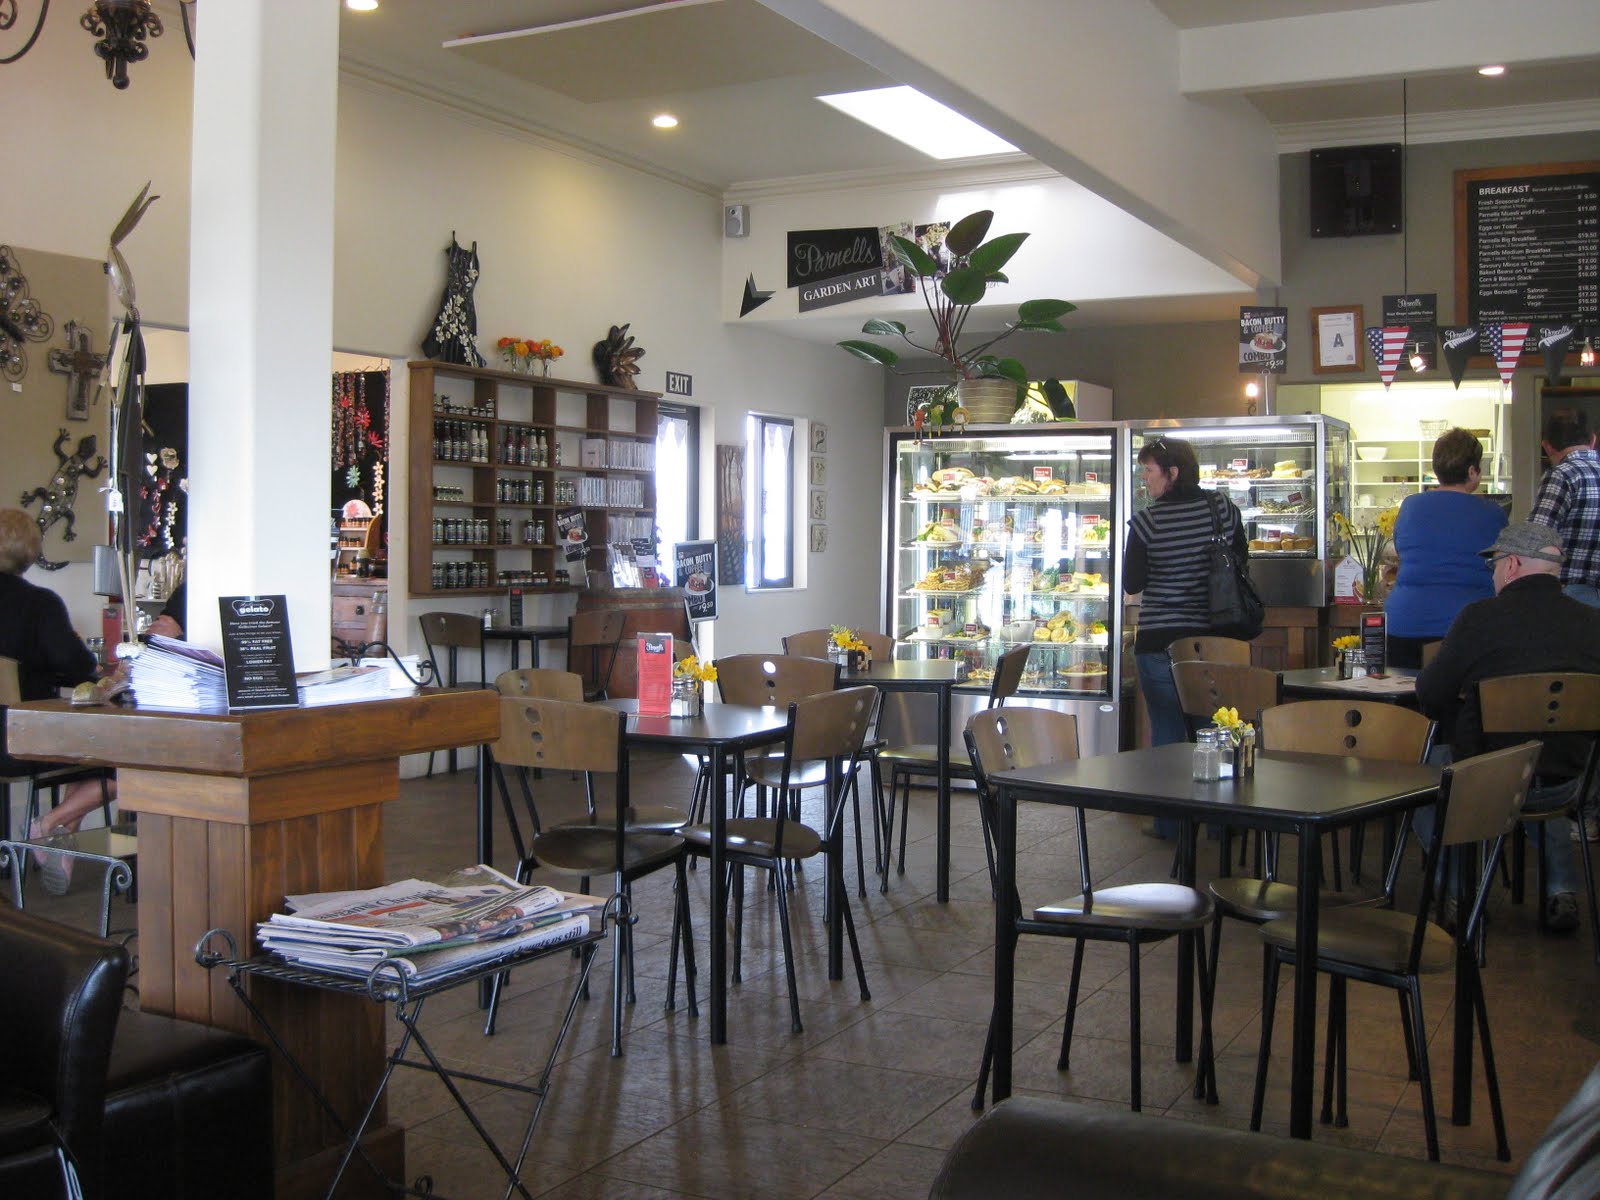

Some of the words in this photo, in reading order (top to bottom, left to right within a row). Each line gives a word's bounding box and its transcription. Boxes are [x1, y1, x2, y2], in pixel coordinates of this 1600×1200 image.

[1479, 185, 1530, 195] BREAKFAST
[794, 236, 876, 277] Parnells
[803, 280, 852, 301] GARDEN
[854, 275, 877, 291] ART
[1240, 317, 1262, 327] BACON
[1264, 316, 1285, 325] BUTTY
[1251, 324, 1273, 333] COFFEE
[1444, 327, 1474, 341] Parnells
[1540, 325, 1570, 338] Parnells
[1333, 333, 1344, 347] A
[1243, 352, 1271, 361] COMBO
[1265, 359, 1284, 369] $9.50
[669, 374, 689, 393] EXIT
[677, 557, 694, 569] BACON
[695, 552, 712, 564] BUTTY
[239, 606, 269, 614] gelato
[698, 601, 714, 613] $9.50
[376, 889, 448, 907] Chronicle
[565, 926, 582, 939] still
